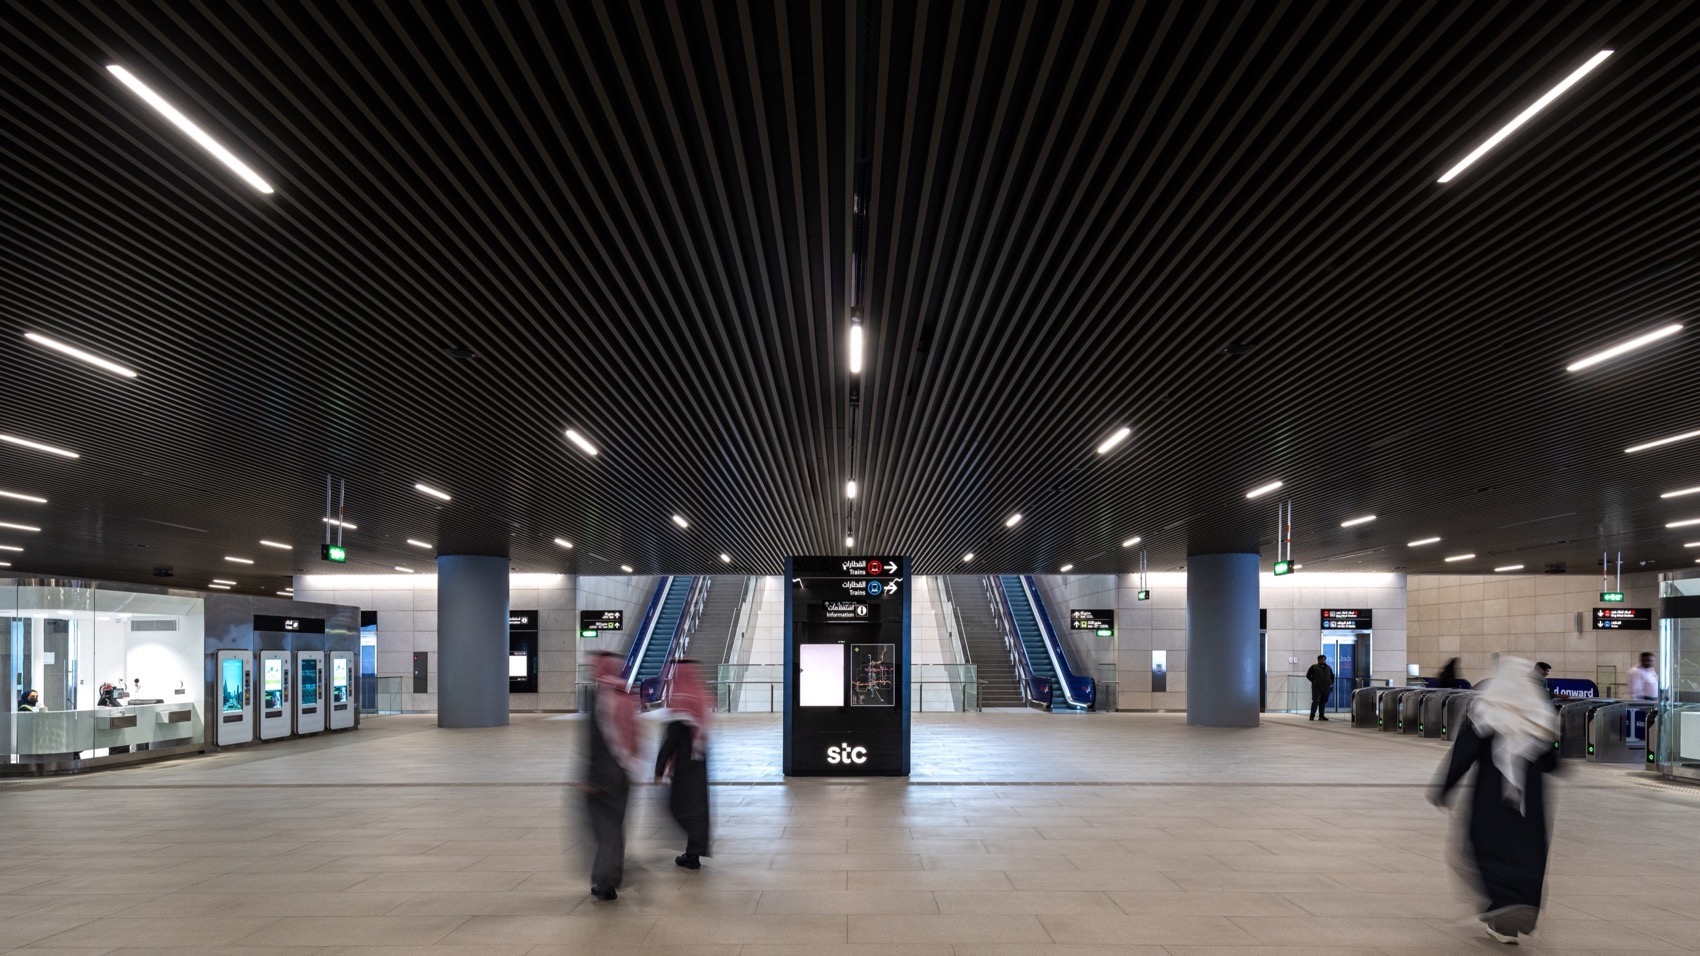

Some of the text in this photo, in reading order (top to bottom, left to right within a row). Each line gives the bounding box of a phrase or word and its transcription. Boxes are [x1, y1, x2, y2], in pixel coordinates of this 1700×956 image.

[842, 561, 866, 569] القطارات
[842, 581, 866, 589] القطارات
[1560, 688, 1594, 698] onward
[827, 742, 867, 763] stc
